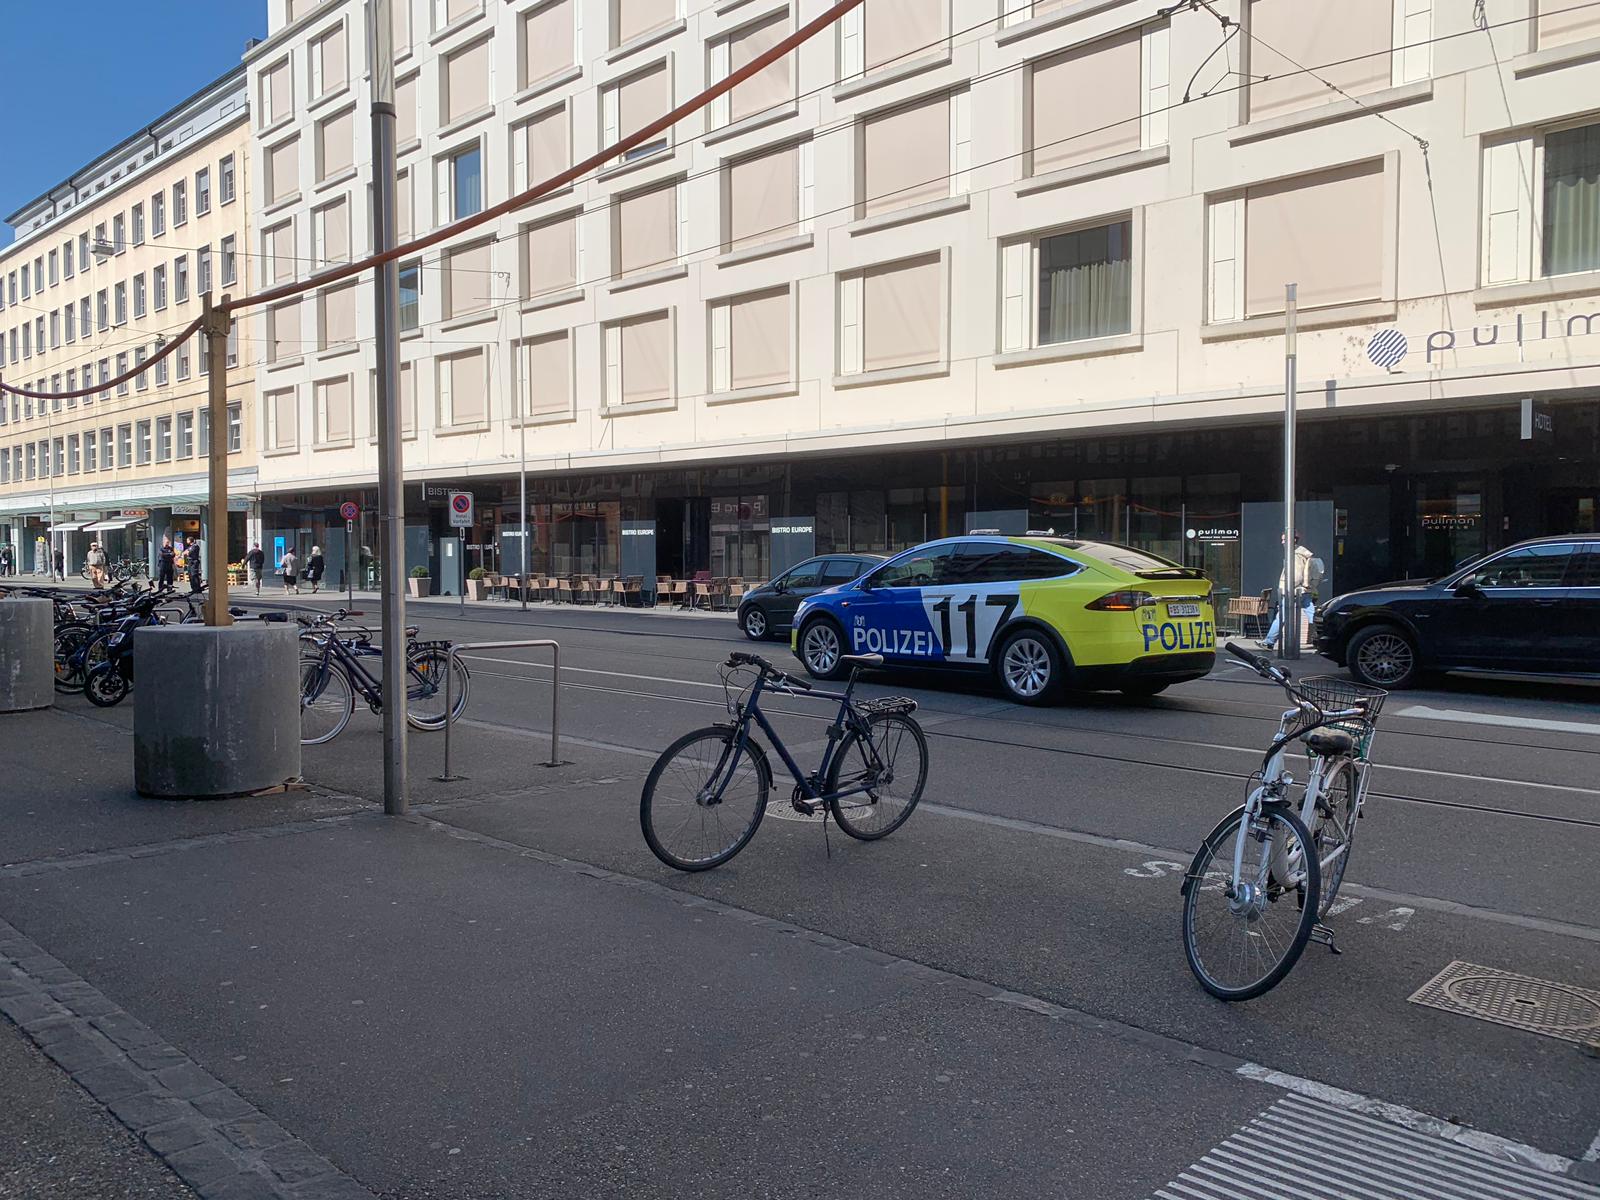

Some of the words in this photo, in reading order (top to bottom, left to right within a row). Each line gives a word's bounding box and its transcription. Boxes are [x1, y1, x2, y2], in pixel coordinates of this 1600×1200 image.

[1535, 411, 1553, 432] HOTEL
[1421, 516, 1475, 527] pullman
[771, 526, 791, 534] BISTRO
[1197, 528, 1239, 537] pullman
[932, 594, 1019, 660] 117
[853, 627, 934, 657] POLIZEI
